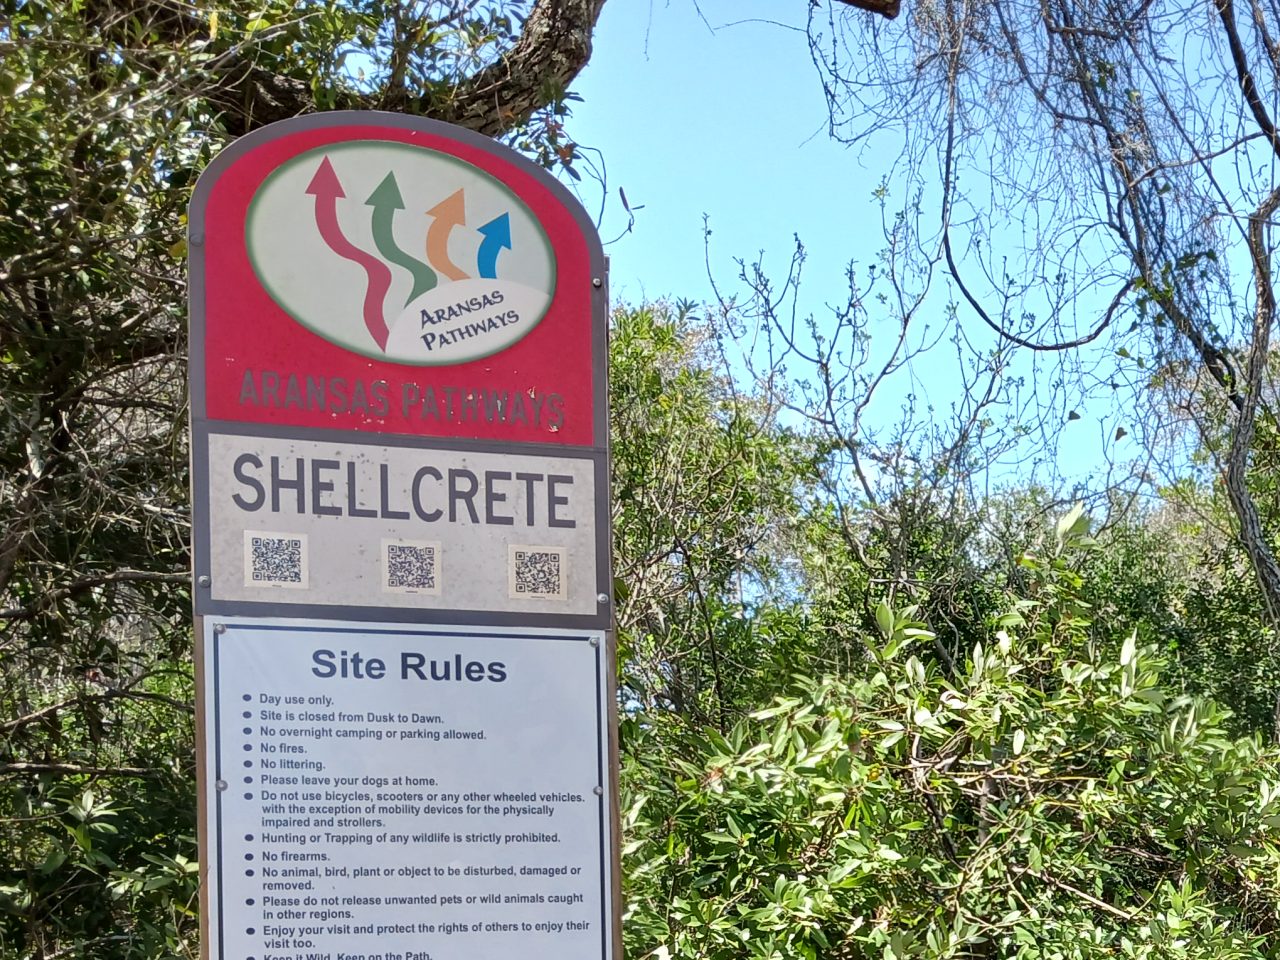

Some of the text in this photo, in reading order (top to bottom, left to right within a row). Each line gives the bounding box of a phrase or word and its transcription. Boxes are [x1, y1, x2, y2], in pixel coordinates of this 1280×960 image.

[420, 290, 504, 330] ARANSAS
[420, 310, 519, 351] PATHWAYS
[239, 370, 565, 429] ARANSAS PATHWAYS
[231, 453, 577, 529] SHELLCRETE
[312, 650, 506, 682] Site Rules
[259, 694, 334, 707] Day use only.
[259, 710, 444, 724] Site is closed from Dusk to Dawn.
[259, 726, 276, 736] No
[278, 727, 332, 739] overnight
[335, 728, 382, 740] camping
[399, 729, 440, 741] parking
[442, 730, 486, 740] allowed.
[260, 742, 307, 753] No fires.
[260, 758, 326, 772] No littering.
[260, 774, 438, 788] Please leave your dogs at home.
[260, 790, 277, 800] Do
[279, 792, 298, 800] not
[325, 791, 373, 803] bicycles,
[376, 792, 423, 801] scooters
[440, 794, 460, 804] any
[462, 792, 491, 801] other
[493, 792, 536, 802] wheeled
[539, 792, 585, 802] vehicles.
[261, 804, 554, 817] with the exception of mobility devices for the physically
[261, 817, 386, 829] impaired and strollers.
[261, 833, 306, 845] Hunting
[323, 833, 372, 845] Trapping
[375, 833, 387, 842] of
[389, 835, 409, 845] any
[411, 833, 450, 842] wildlife
[453, 832, 462, 842] is
[465, 833, 501, 844] strictly
[504, 832, 560, 844] prohibited.
[261, 851, 330, 861] No firearms.
[261, 867, 278, 877] No
[281, 867, 321, 878] animal,
[324, 866, 349, 878] bird,
[352, 866, 380, 879] plant
[397, 866, 431, 878] object
[433, 866, 444, 876] to
[447, 866, 460, 876] be
[463, 866, 516, 876] disturbed,
[519, 866, 567, 877] damaged
[569, 867, 582, 875] or
[262, 880, 314, 890] removed.
[262, 893, 583, 906] Please do not release unwanted pets or wild animals caught
[262, 909, 354, 921] in other regions.
[263, 920, 590, 937] Enjoy your visit and protect the rights of others to enjoy their
[263, 939, 315, 948] visit too.
[405, 952, 432, 960] Path.
